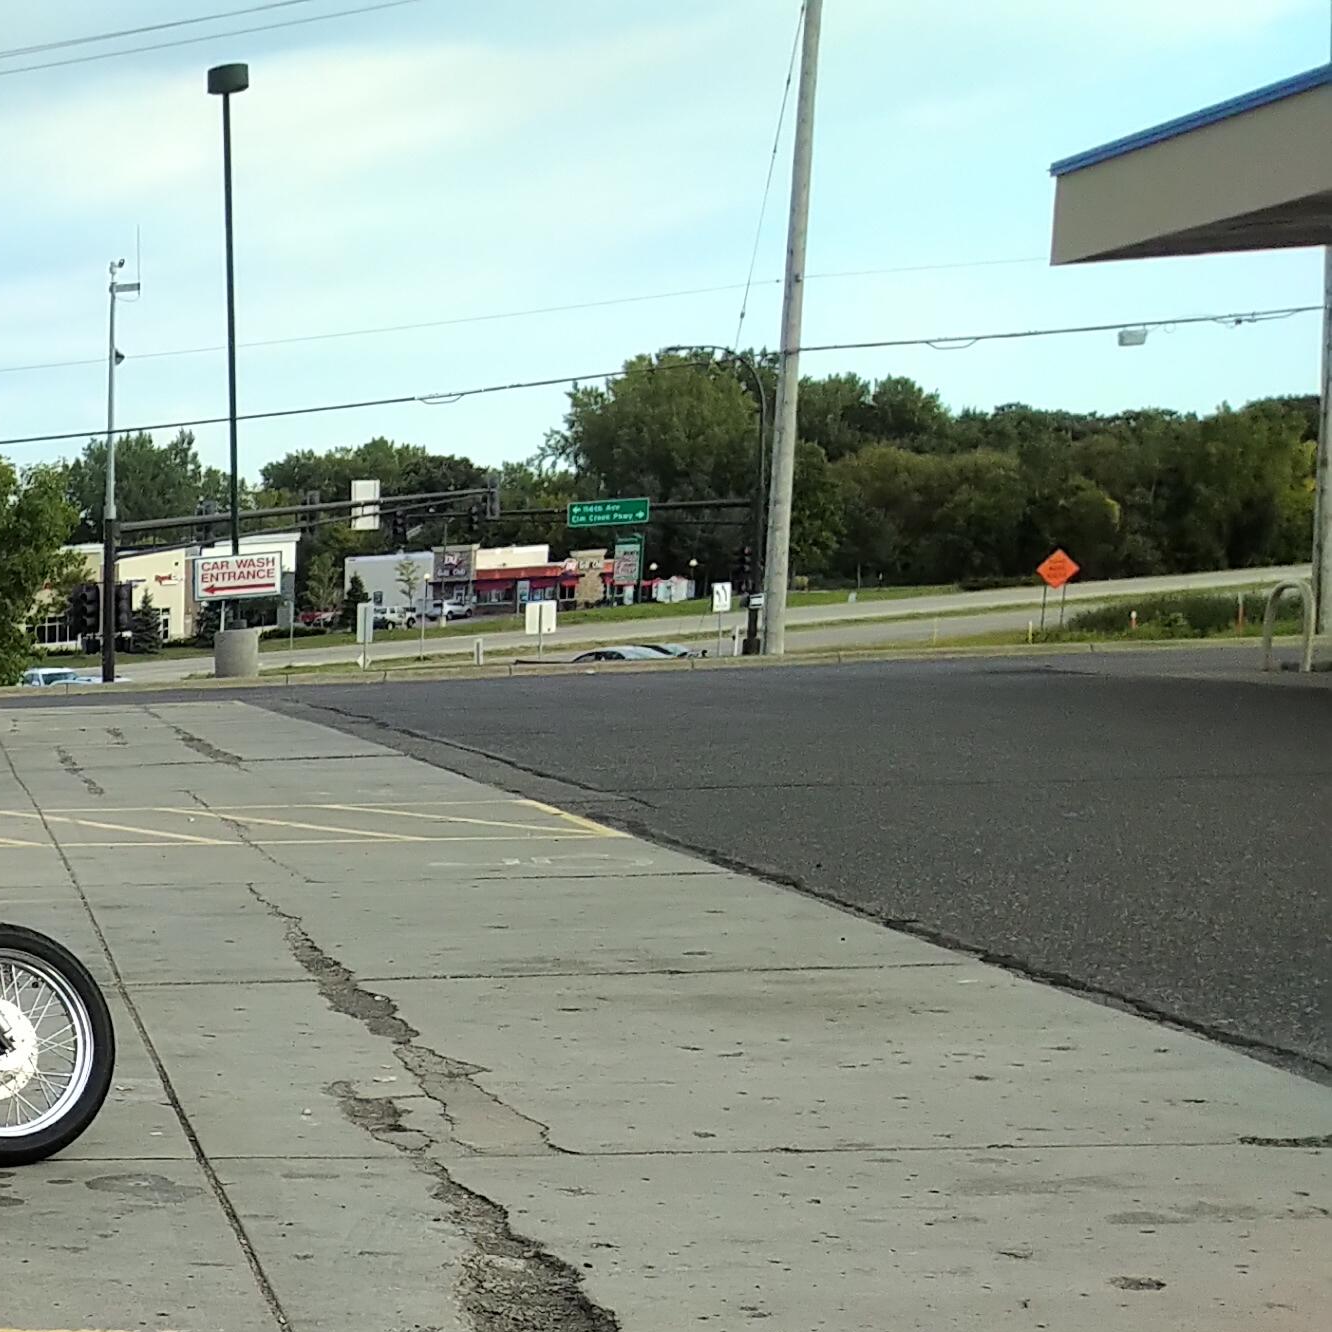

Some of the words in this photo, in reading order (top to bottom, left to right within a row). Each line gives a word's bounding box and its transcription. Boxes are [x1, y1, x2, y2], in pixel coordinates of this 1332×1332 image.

[201, 560, 229, 572] CAR
[236, 557, 275, 569] WASH
[201, 568, 275, 583] ENTRANCE
